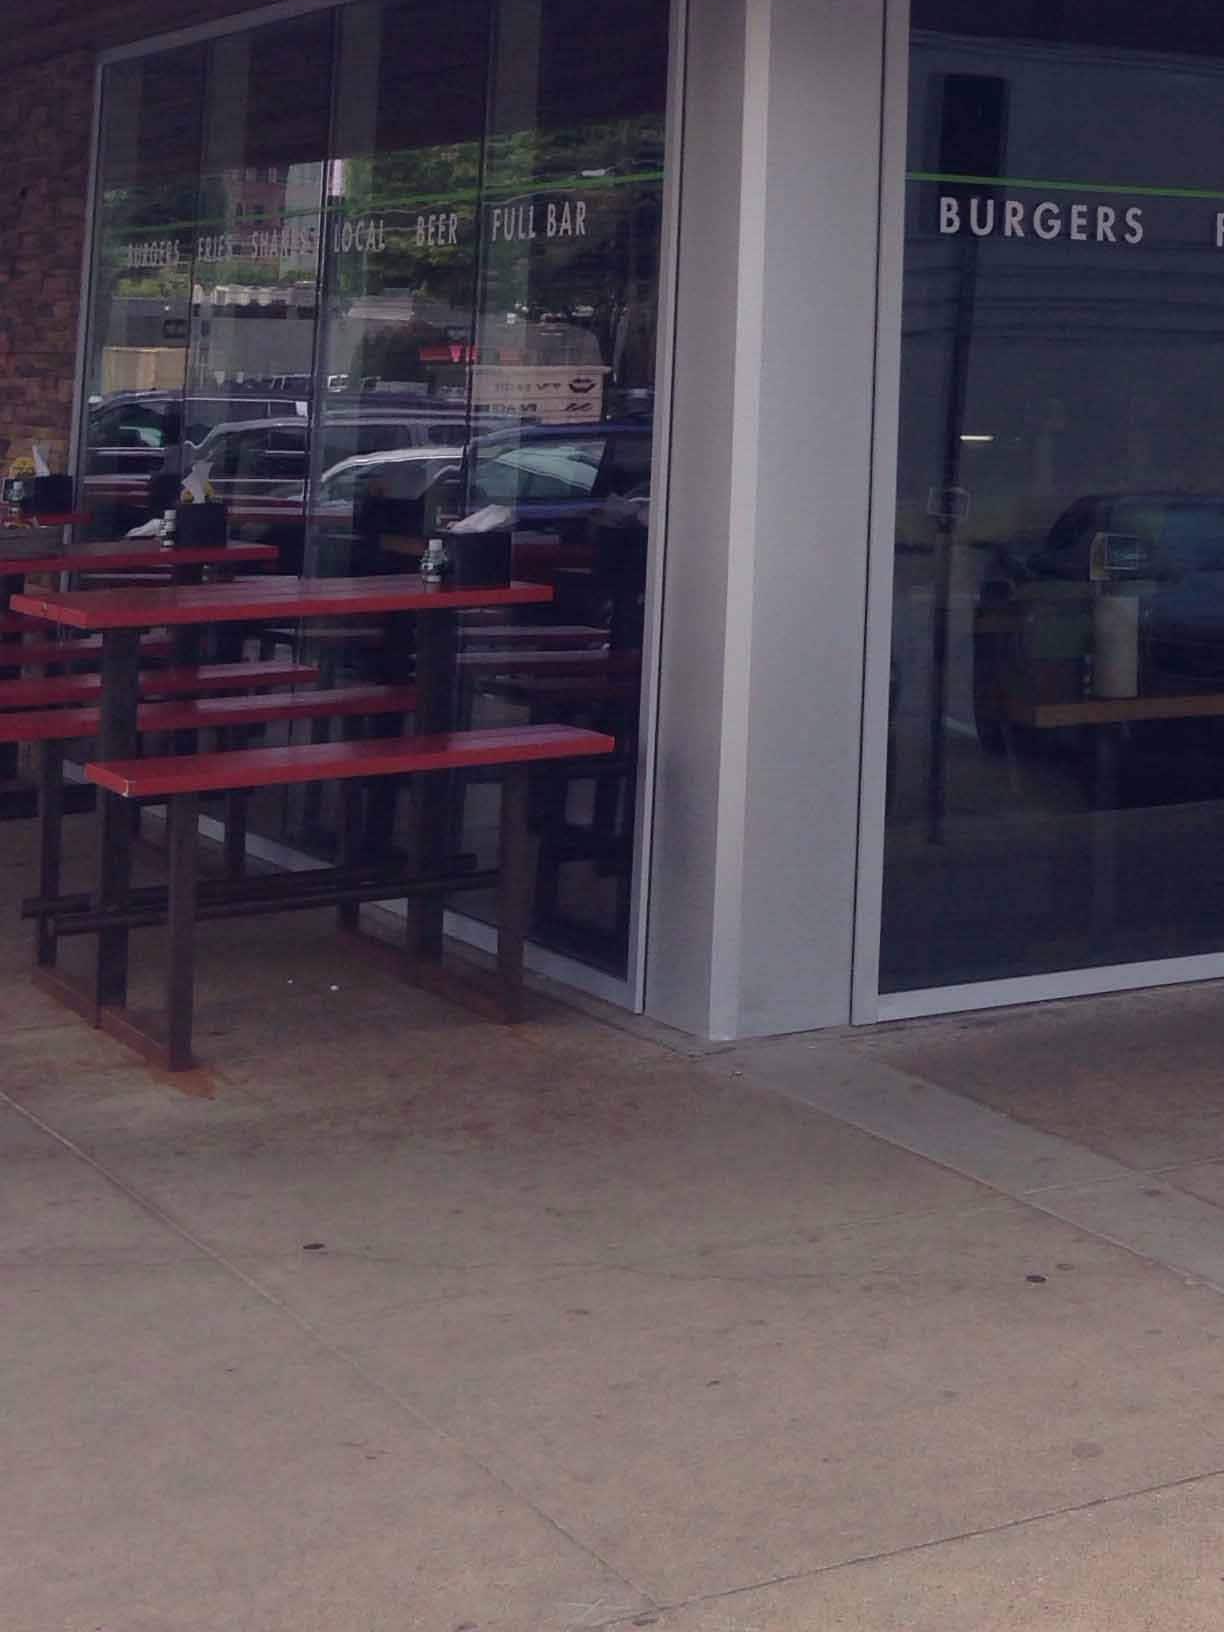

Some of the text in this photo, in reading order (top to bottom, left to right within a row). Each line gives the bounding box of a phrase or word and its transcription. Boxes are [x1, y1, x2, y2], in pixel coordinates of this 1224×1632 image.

[334, 219, 386, 253] LOCAL
[415, 212, 458, 247] BEER
[492, 204, 536, 241] FULL
[546, 200, 587, 237] BAR
[938, 196, 1144, 244] BURGERS
